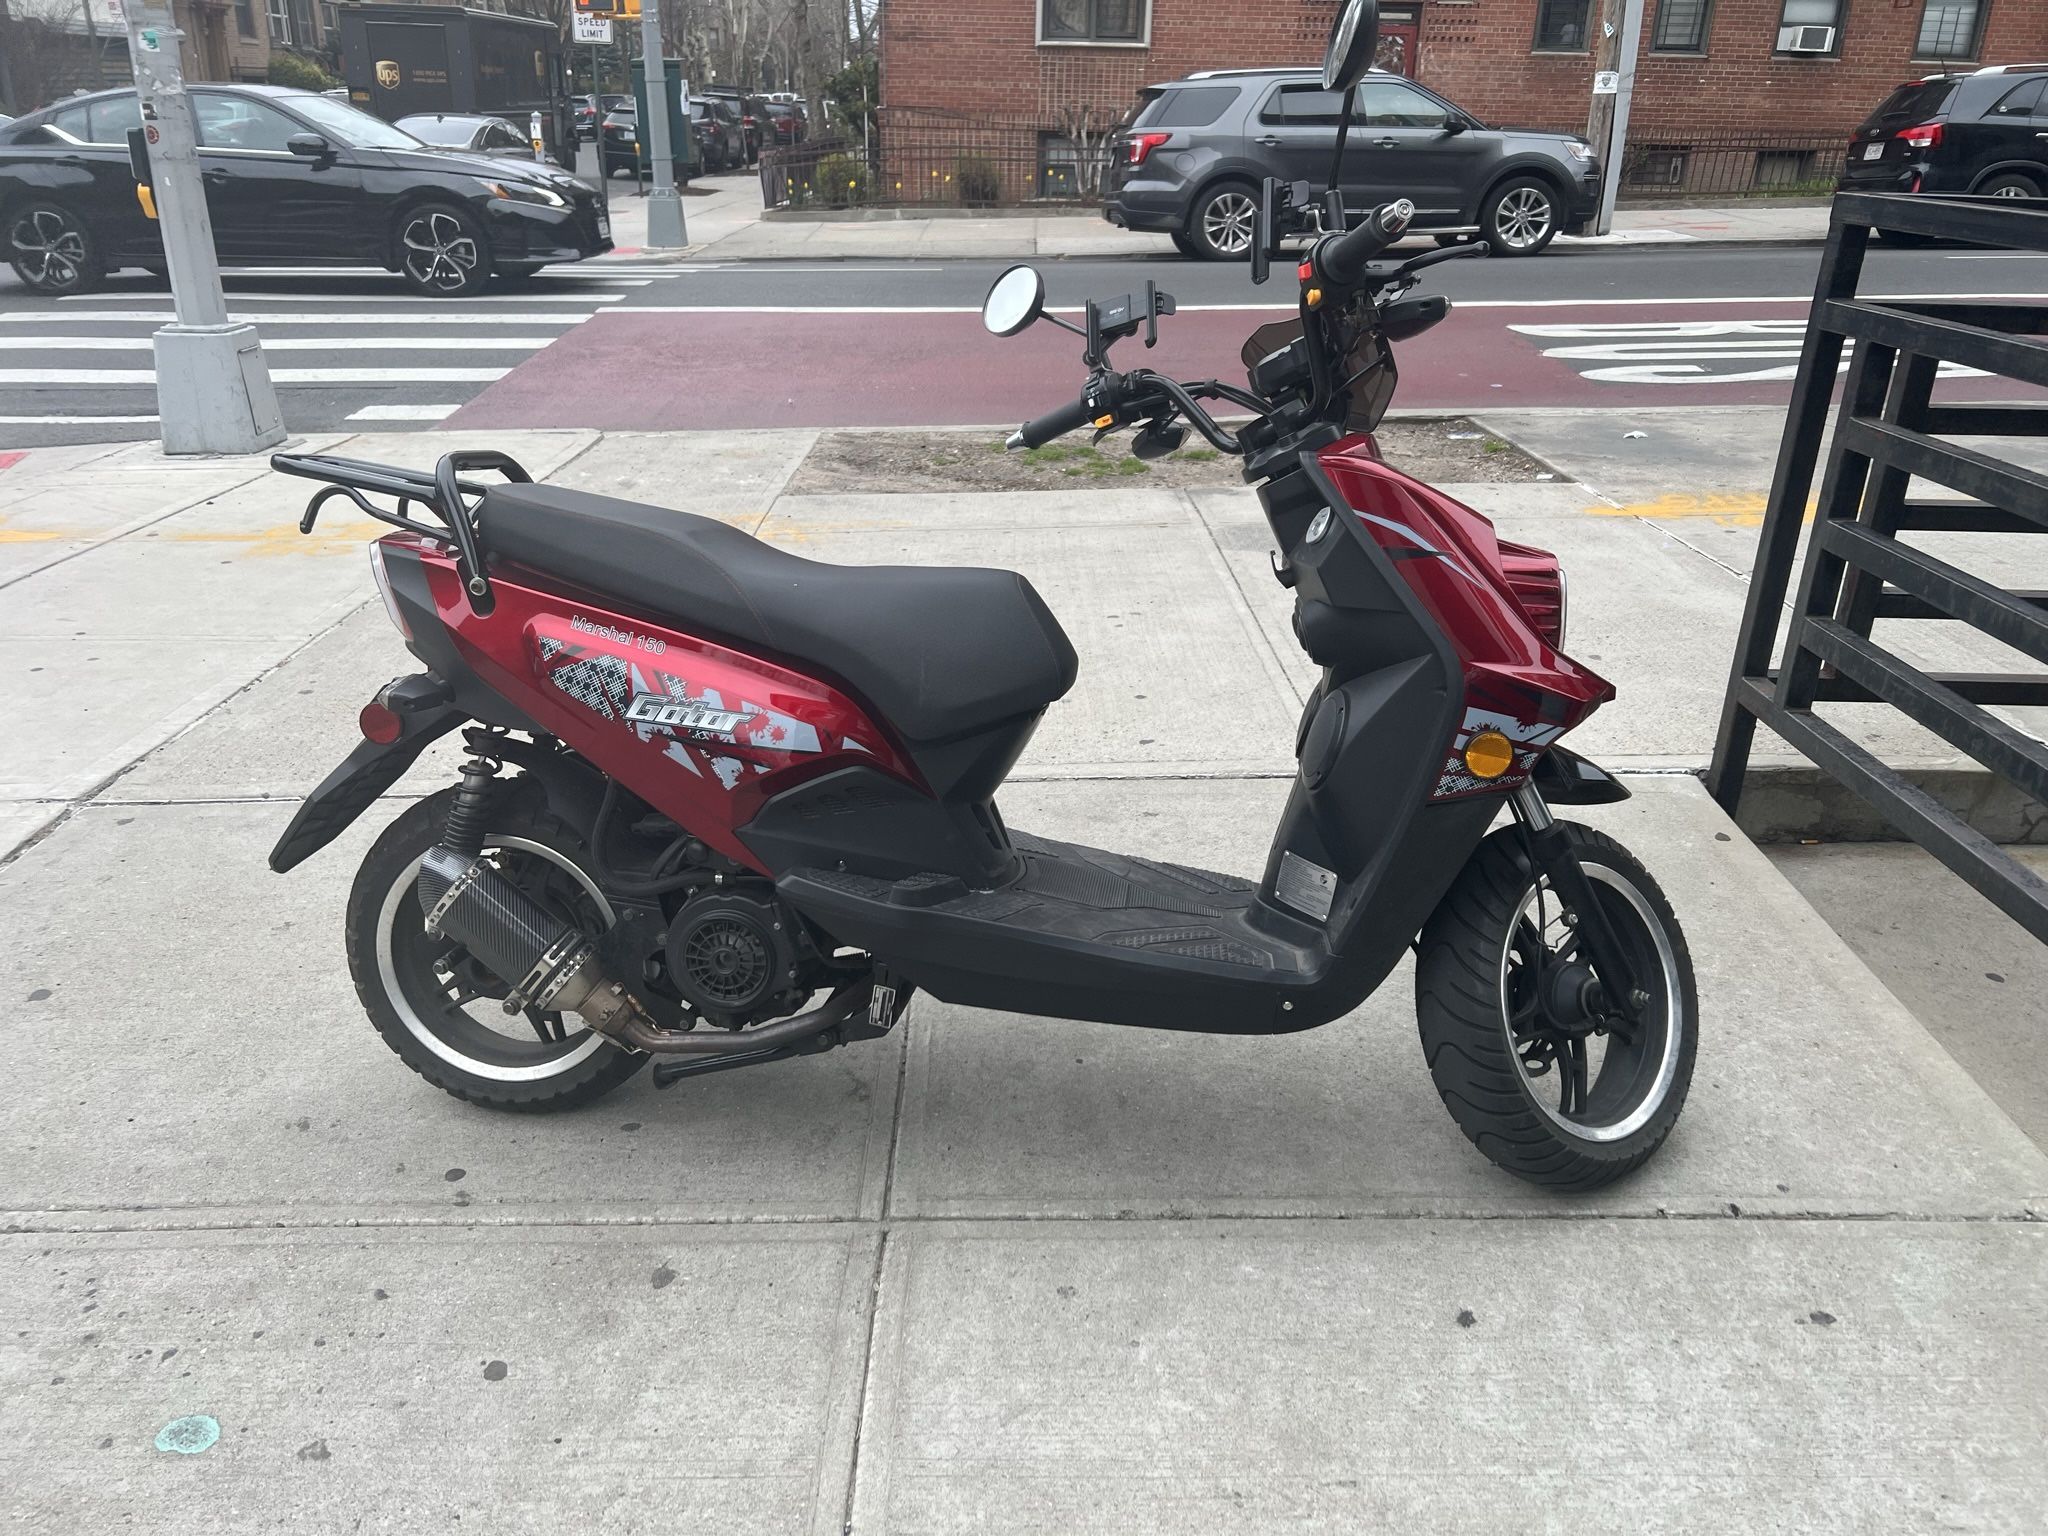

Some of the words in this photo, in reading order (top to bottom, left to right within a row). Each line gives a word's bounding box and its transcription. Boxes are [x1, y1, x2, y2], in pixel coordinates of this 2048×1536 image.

[577, 17, 606, 27] SPEED
[581, 29, 603, 39] LIMIT
[380, 69, 399, 85] ups
[571, 615, 634, 646] Marshal
[637, 634, 666, 655] 150
[623, 691, 756, 735] Gator
